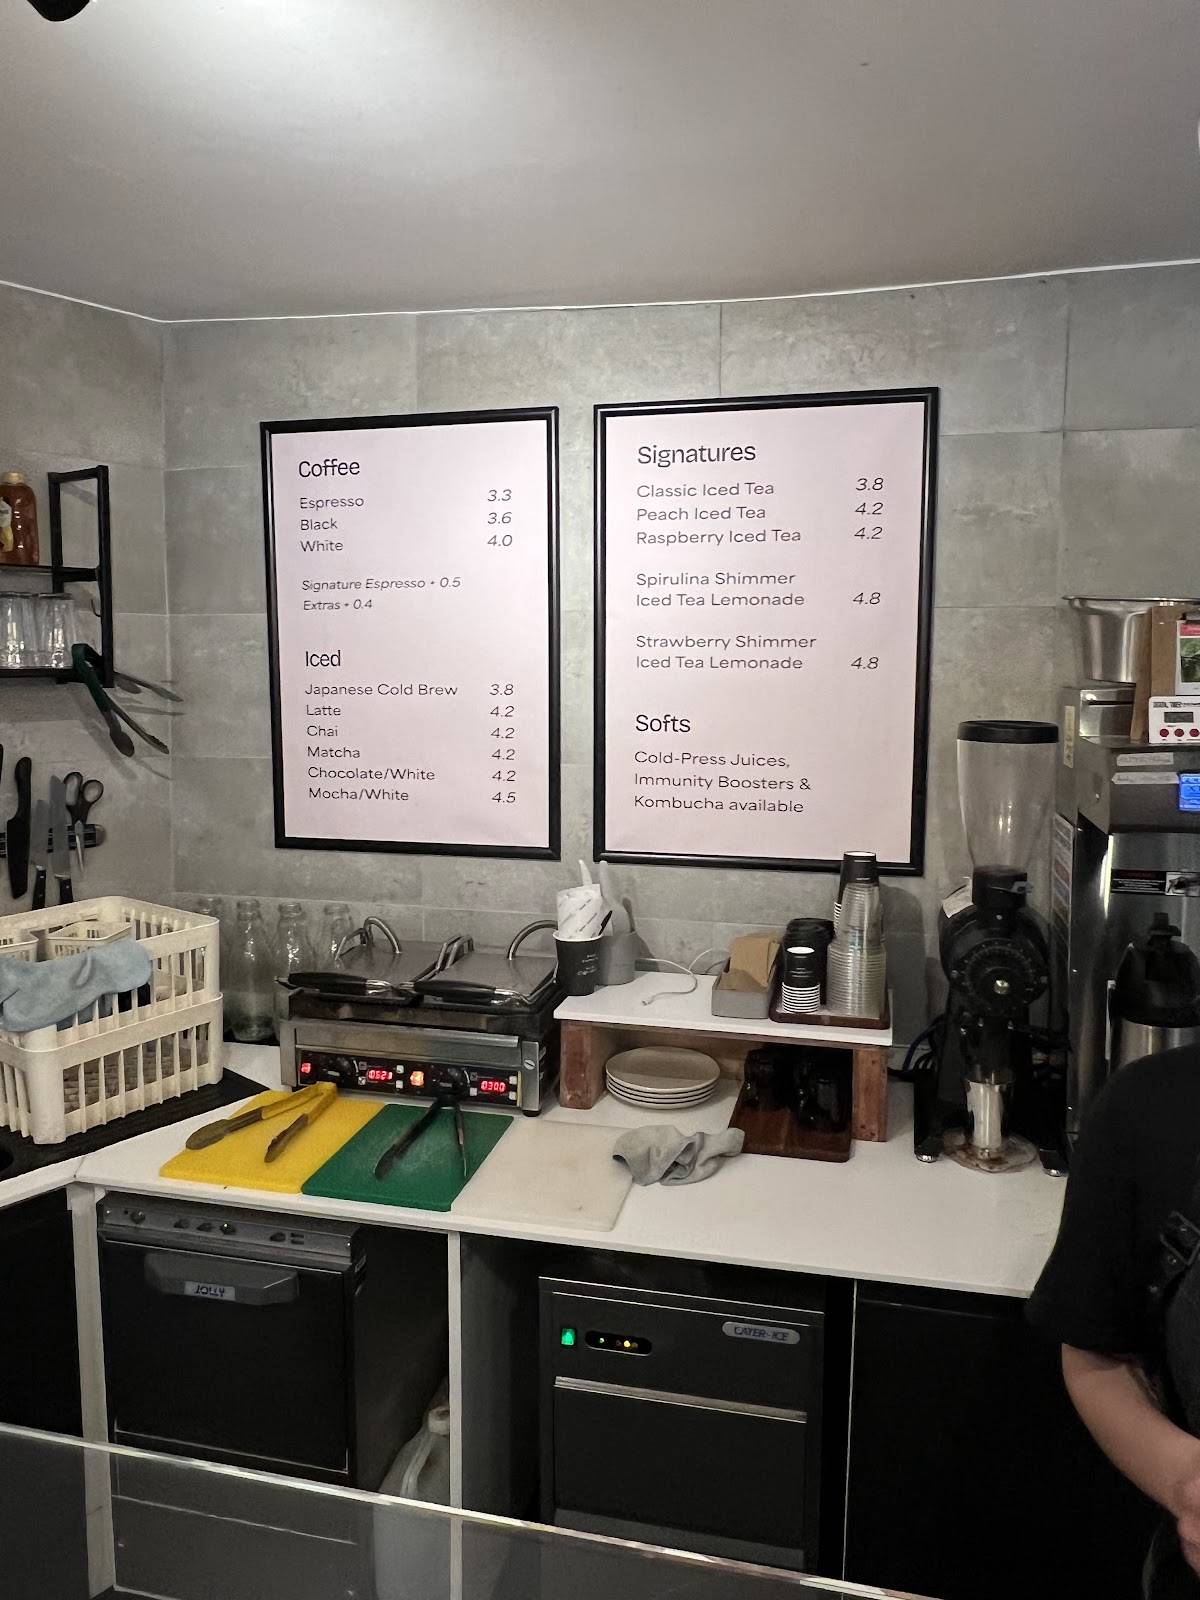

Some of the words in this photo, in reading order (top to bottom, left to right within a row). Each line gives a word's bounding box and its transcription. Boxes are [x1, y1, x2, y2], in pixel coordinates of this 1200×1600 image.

[637, 444, 757, 469] Signatures
[298, 458, 361, 478] Coffee
[636, 483, 698, 498] Classic
[702, 482, 741, 497] Iced
[743, 481, 775, 496] Tea
[855, 477, 884, 492] 3.8
[299, 497, 365, 512] Espresso
[487, 488, 513, 502] 3.3
[636, 507, 689, 521] Peach
[694, 506, 732, 520] Iced
[735, 505, 766, 520] Tea
[854, 501, 884, 516] 4.2
[300, 517, 339, 531] Black
[487, 511, 513, 525] 3.6
[299, 539, 344, 553] White
[486, 534, 513, 547] 4.0
[636, 530, 725, 547] Raspberry
[729, 529, 767, 544] Iced
[770, 528, 802, 543] Tea
[853, 526, 883, 540] 4.2
[301, 578, 363, 593] Signature
[364, 577, 426, 592] Espresso
[439, 576, 462, 589] 0.5
[635, 571, 710, 589] Spirulina
[714, 571, 797, 586] Shimmer
[302, 599, 342, 612] Extras
[352, 598, 373, 611] 0.4
[636, 593, 672, 607] Iced
[675, 593, 706, 607] Tea
[711, 592, 805, 607] Lemonade
[852, 591, 881, 606] 4.8
[635, 635, 732, 652] Strawberry
[735, 634, 818, 649] Shimmer
[304, 649, 342, 668] Iced
[636, 655, 671, 669] Iced
[674, 655, 705, 669] Tea
[709, 655, 803, 670] Lemonade
[850, 656, 880, 670] 4.8
[304, 683, 374, 698] Japanese
[376, 683, 414, 697] Cold
[416, 683, 459, 697] Brew
[488, 683, 514, 696] 3.8
[305, 704, 342, 717] Latte
[489, 705, 515, 718] 4.2
[305, 724, 338, 738] Chai
[489, 727, 516, 740] 4.2
[635, 713, 691, 733] Softs
[307, 745, 361, 759] Matcha
[490, 748, 517, 761] 4.2
[634, 750, 727, 767] Cold-Press
[729, 752, 791, 769] Juices,
[307, 766, 436, 782] Chocolate/White
[491, 769, 517, 782] 4.2
[634, 772, 714, 790] Immunity
[718, 774, 795, 791] Boosters
[798, 776, 813, 791] &
[308, 787, 409, 802] Mocha/White
[491, 791, 517, 804] 4.5
[635, 795, 725, 811] Kombucha
[728, 797, 805, 813] available
